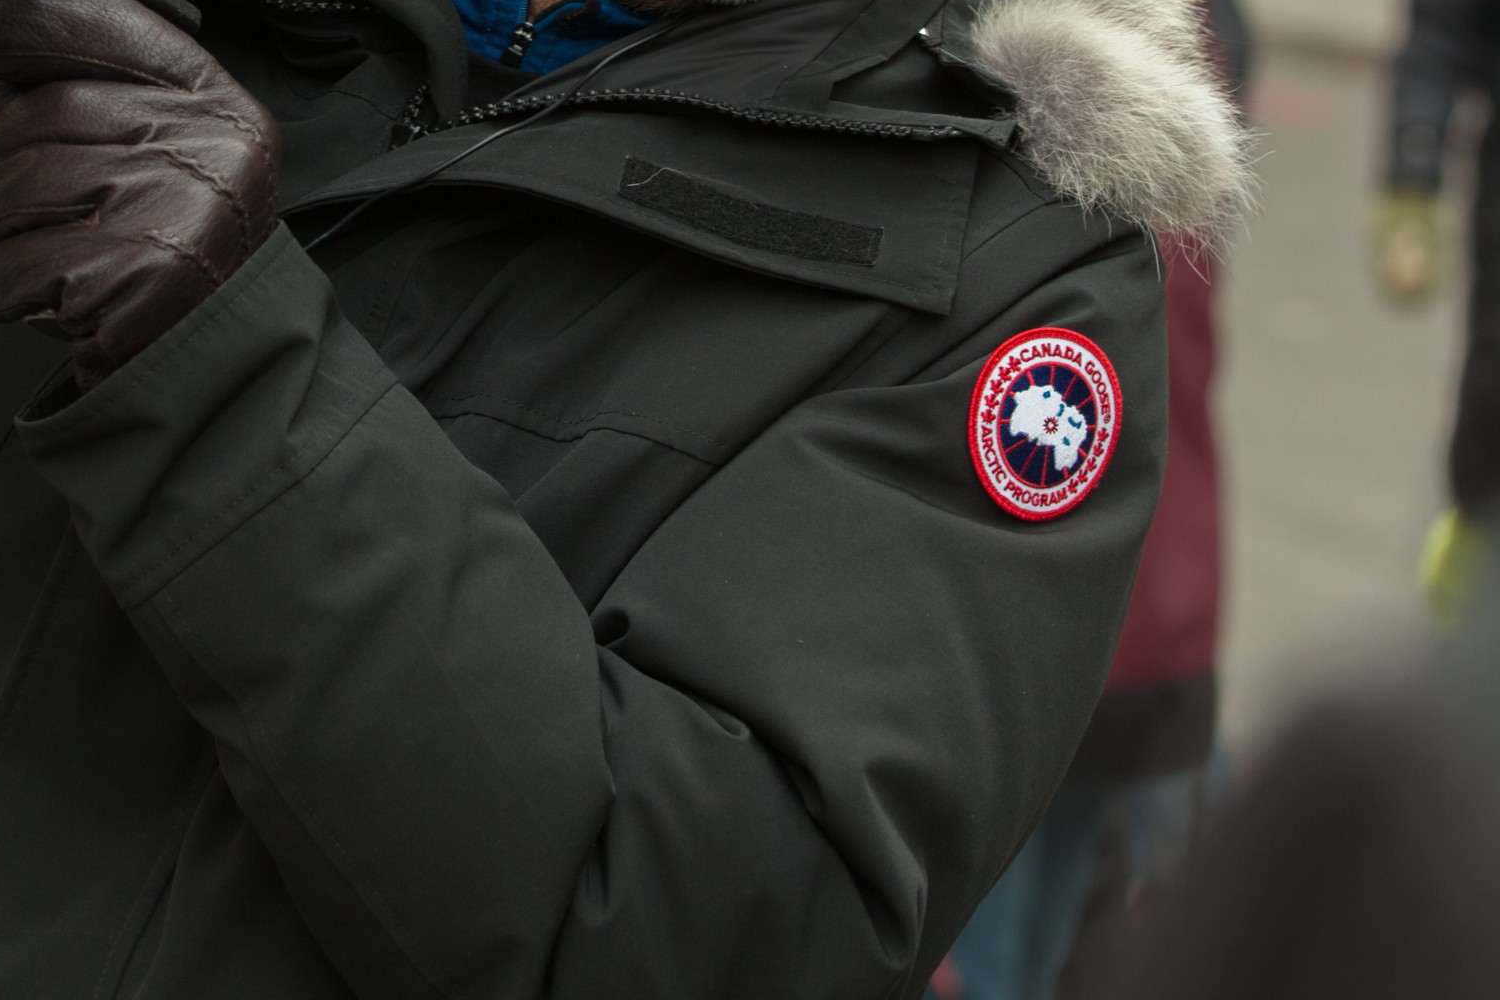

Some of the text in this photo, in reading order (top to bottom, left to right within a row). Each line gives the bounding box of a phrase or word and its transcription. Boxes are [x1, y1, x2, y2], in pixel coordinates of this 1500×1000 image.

[1019, 343, 1082, 367] CANADA
[980, 425, 1068, 507] ARCTIC PROGRAM
